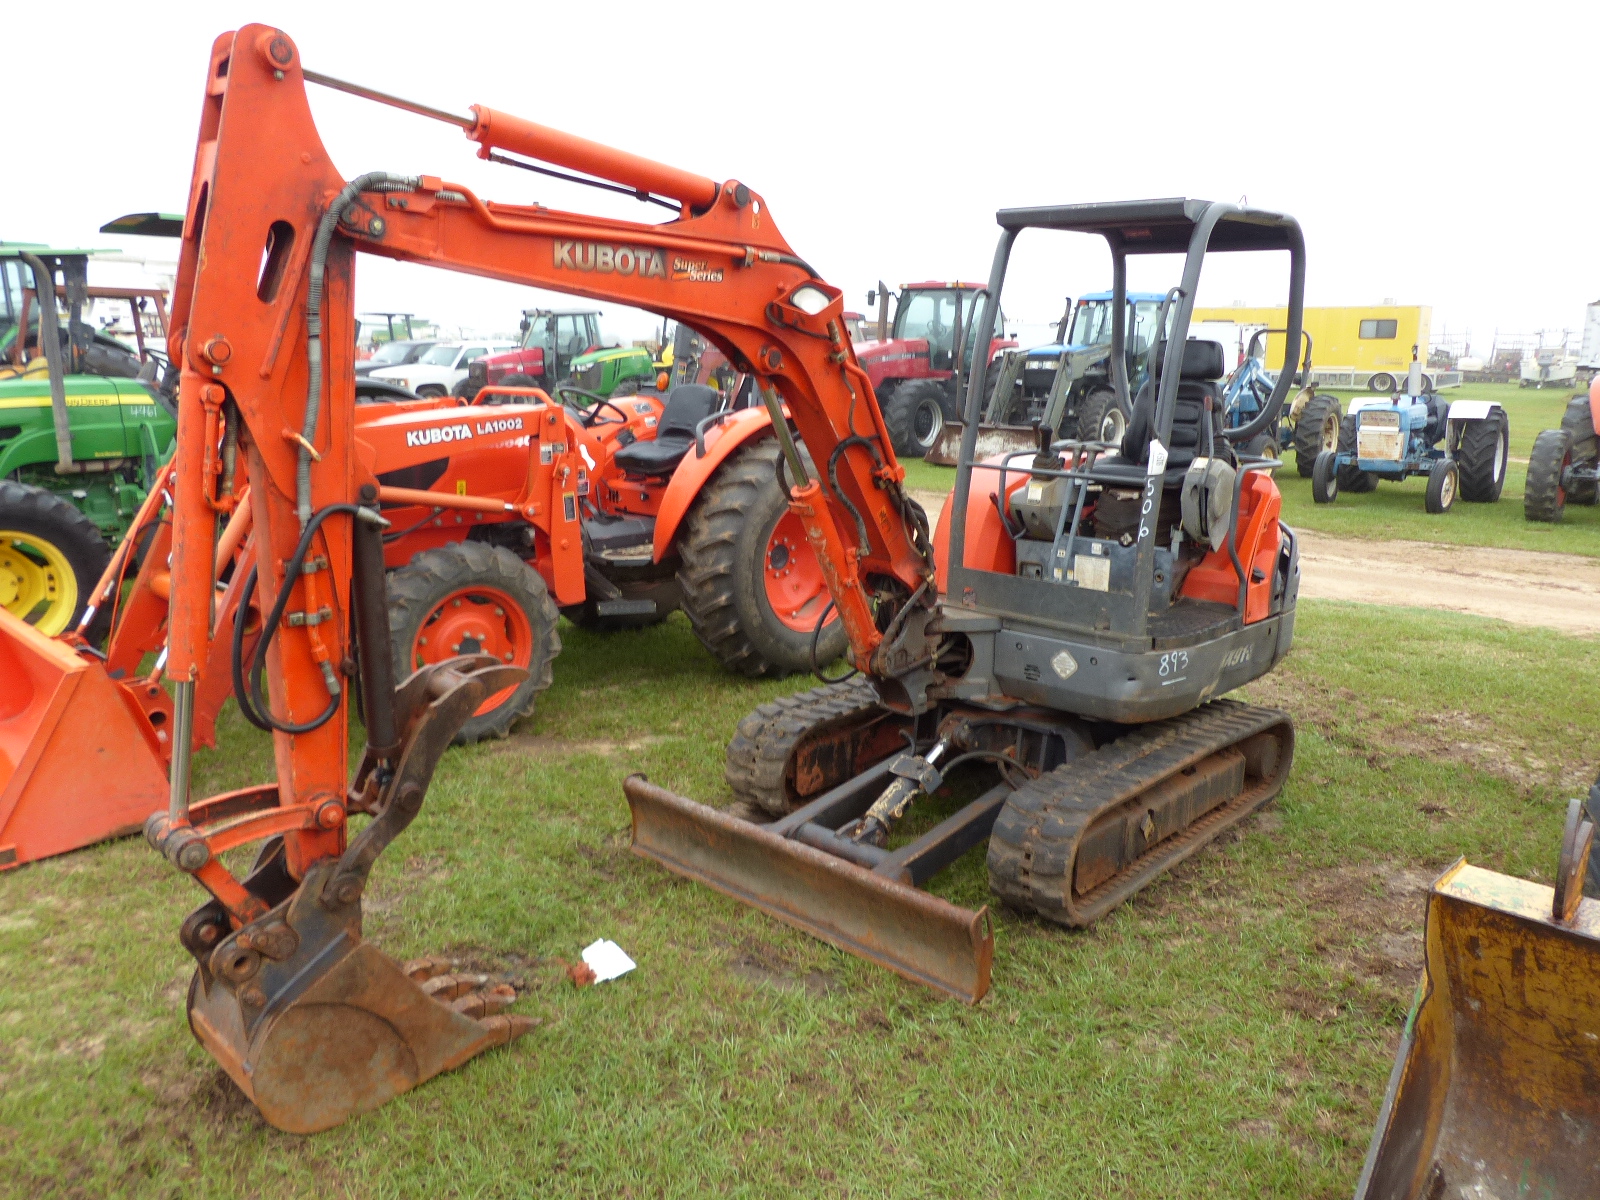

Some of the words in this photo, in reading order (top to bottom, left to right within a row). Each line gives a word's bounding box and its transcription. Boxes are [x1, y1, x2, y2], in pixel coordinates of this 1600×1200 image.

[553, 239, 667, 279] KUBOTA
[674, 256, 708, 273] Super
[690, 269, 723, 282] Series
[406, 424, 473, 447] KUBOTA
[476, 417, 523, 435] LA1002
[1159, 651, 1189, 677] 893
